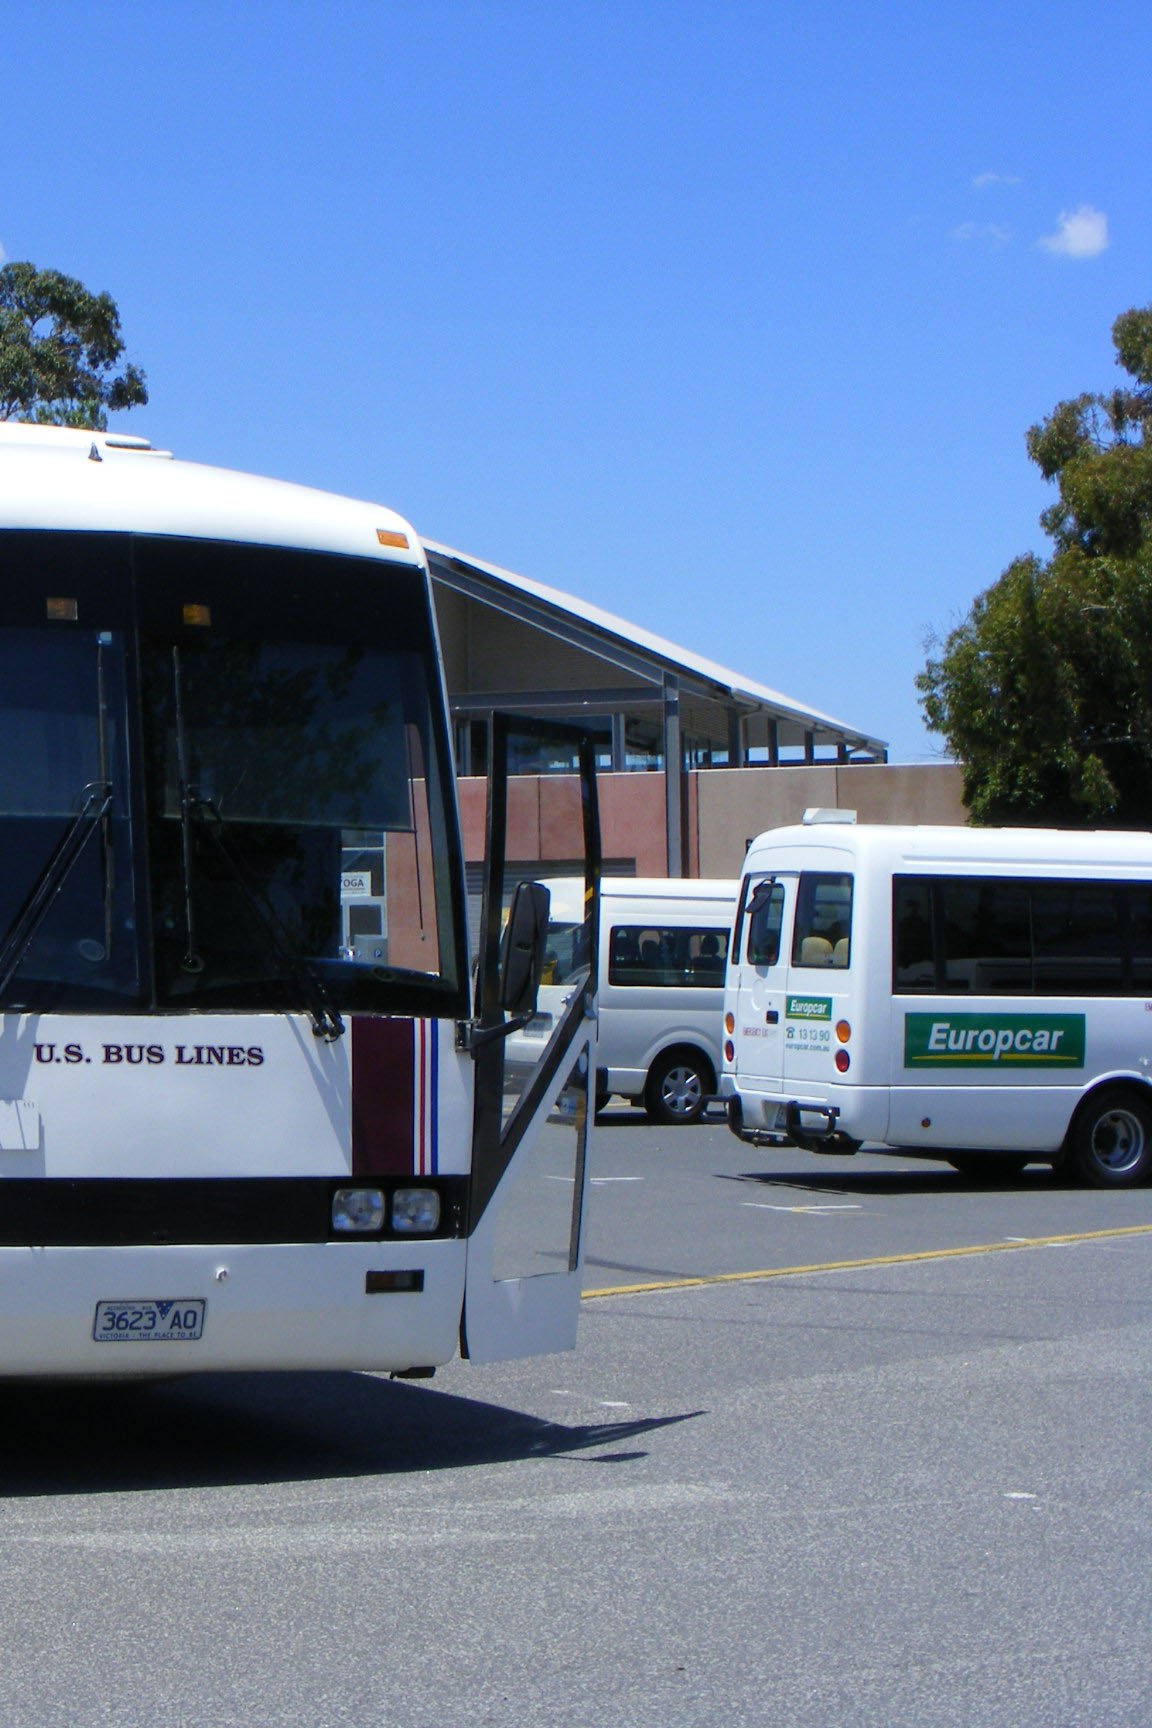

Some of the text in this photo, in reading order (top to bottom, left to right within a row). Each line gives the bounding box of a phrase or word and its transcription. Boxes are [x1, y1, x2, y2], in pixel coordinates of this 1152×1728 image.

[341, 878, 364, 888] OGA
[790, 999, 827, 1016] Europcar
[799, 1028, 830, 1042] 13 13 90
[928, 1022, 1064, 1060] Europcar
[34, 1044, 264, 1066] U.S. BUS LINES
[102, 1311, 157, 1331] 3623
